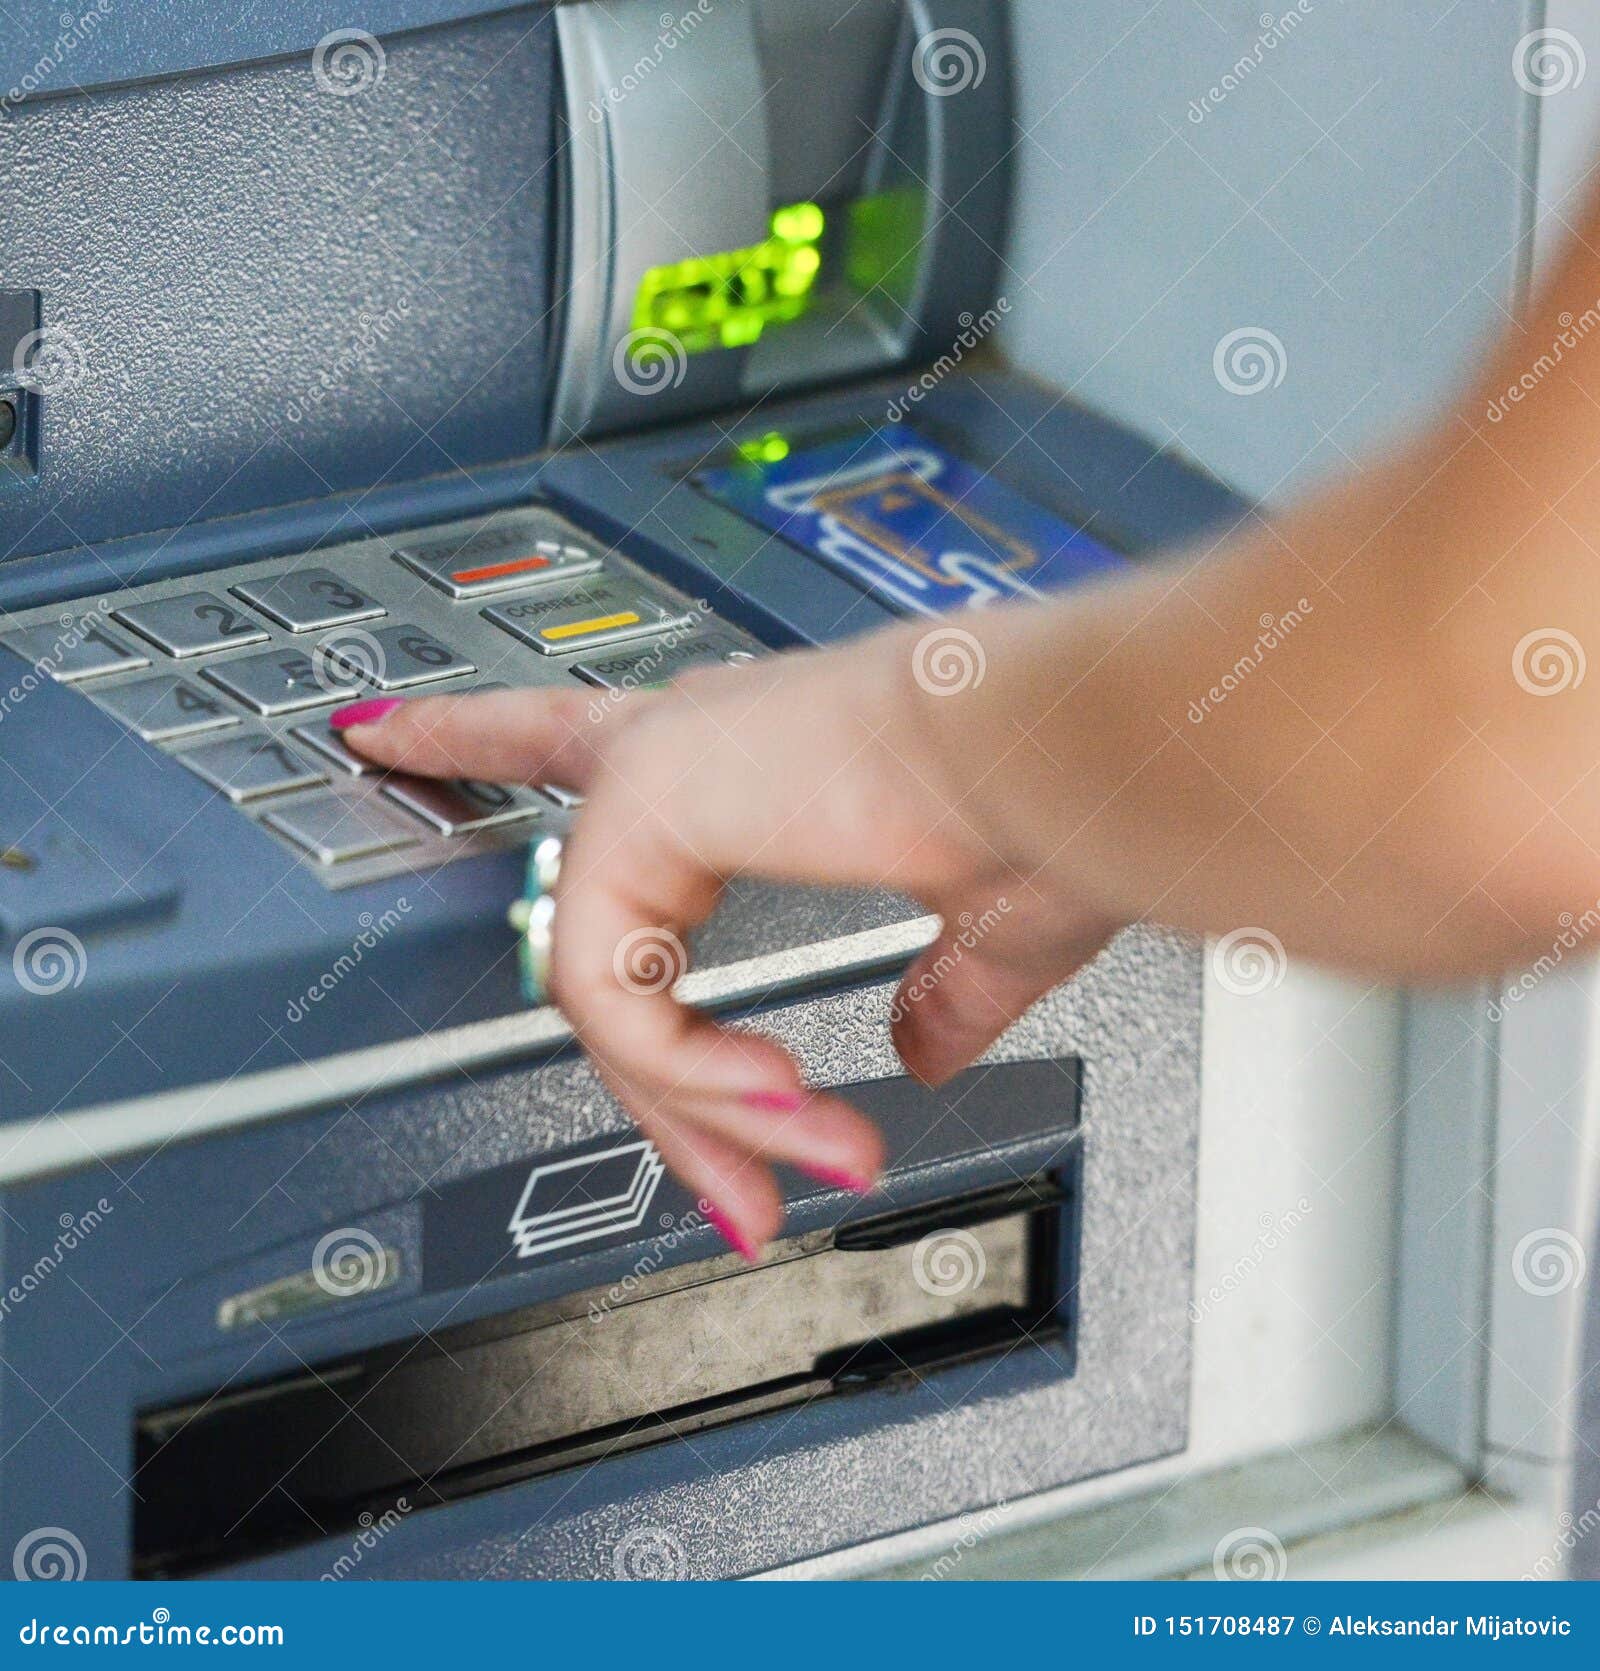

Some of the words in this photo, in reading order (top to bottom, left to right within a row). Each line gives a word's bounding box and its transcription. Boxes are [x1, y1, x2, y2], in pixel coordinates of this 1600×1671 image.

[309, 580, 366, 610] 3
[194, 605, 254, 636] 2
[83, 628, 132, 658] 1
[399, 636, 453, 666] 6
[278, 658, 336, 692] 5
[174, 685, 223, 716] 4
[249, 743, 299, 774] 7
